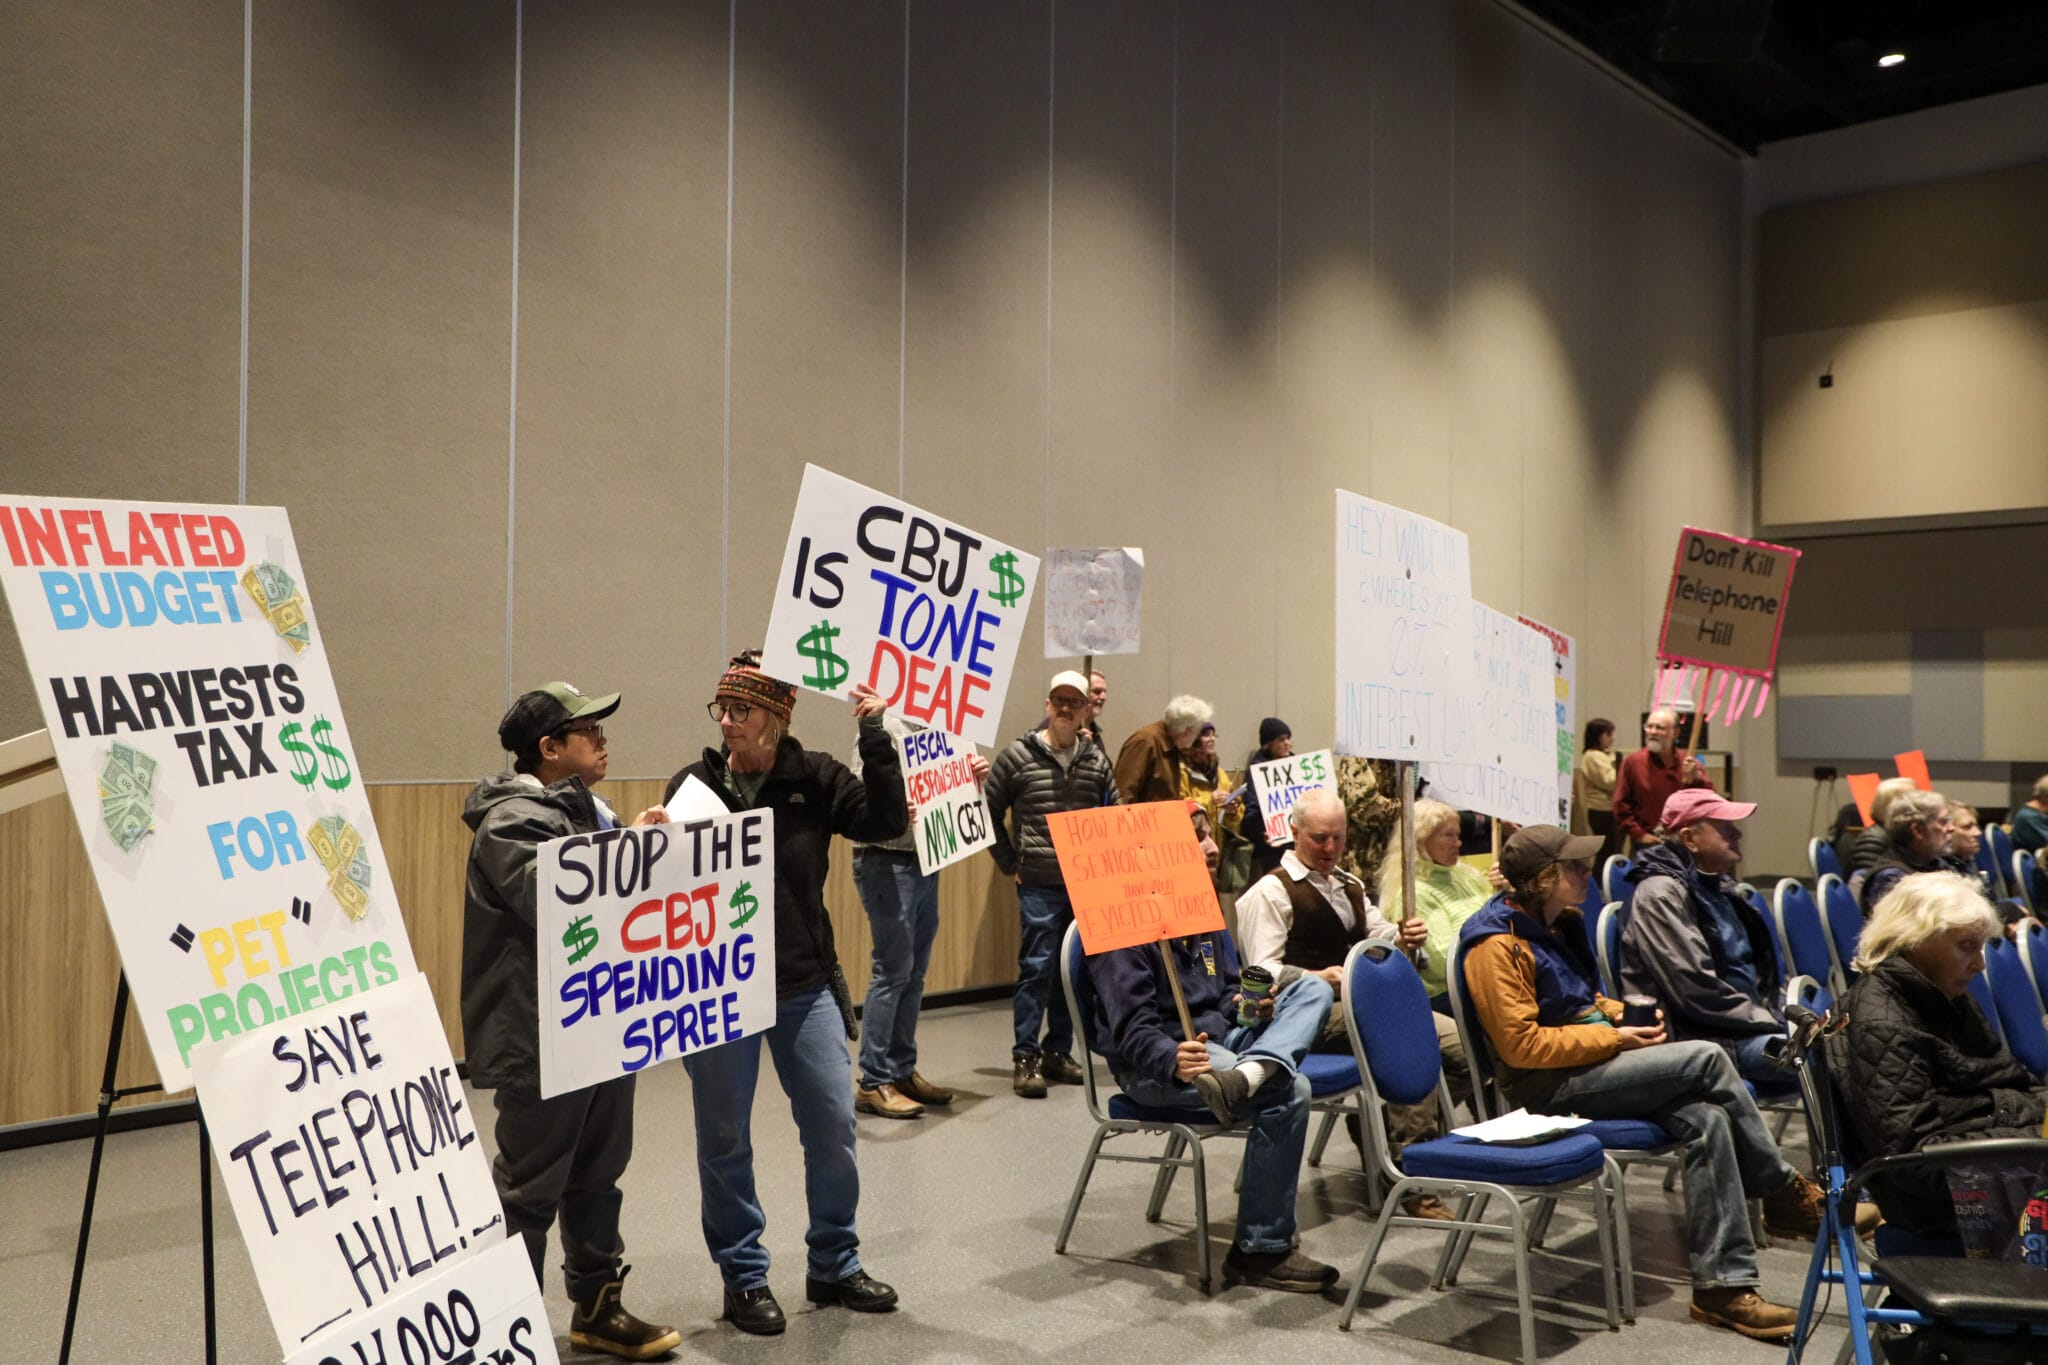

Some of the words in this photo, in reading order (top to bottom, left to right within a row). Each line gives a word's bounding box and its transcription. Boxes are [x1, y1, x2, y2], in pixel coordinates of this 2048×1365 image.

[0, 506, 246, 567] INFLATED
[856, 505, 982, 597] CBJ
[1346, 506, 1386, 558] HEY
[1743, 552, 1775, 577] Kill
[39, 571, 243, 631] BUDGET
[792, 536, 848, 609] IS
[870, 568, 1001, 677] TONE
[1676, 575, 1778, 615] Telephone
[1697, 619, 1734, 647] Hill
[49, 663, 305, 738] HARVESTS
[868, 640, 991, 736] DEAF
[1345, 681, 1434, 753] INTEREST
[174, 722, 278, 787] TAX
[278, 713, 352, 793] $$
[904, 731, 954, 769] FISCAL
[1260, 763, 1295, 788] TAX
[924, 801, 957, 867] NOW
[957, 800, 986, 845] CBJ
[1065, 815, 1108, 847] HOW
[1117, 808, 1160, 836] MANY
[1266, 813, 1287, 838] NOT
[1269, 783, 1323, 813] MATT
[206, 809, 306, 880] FOR
[555, 827, 669, 905] STOP
[685, 816, 762, 877] THE
[1072, 847, 1143, 882] SENIOR
[621, 882, 719, 953] CBJ
[166, 941, 400, 1069] PROJECTS
[560, 933, 756, 1028] SPENDING
[273, 1010, 382, 1092] SAVE
[622, 991, 743, 1072] SPREE
[230, 1066, 475, 1236] TELEPHONE
[335, 1172, 468, 1308] HILL!
